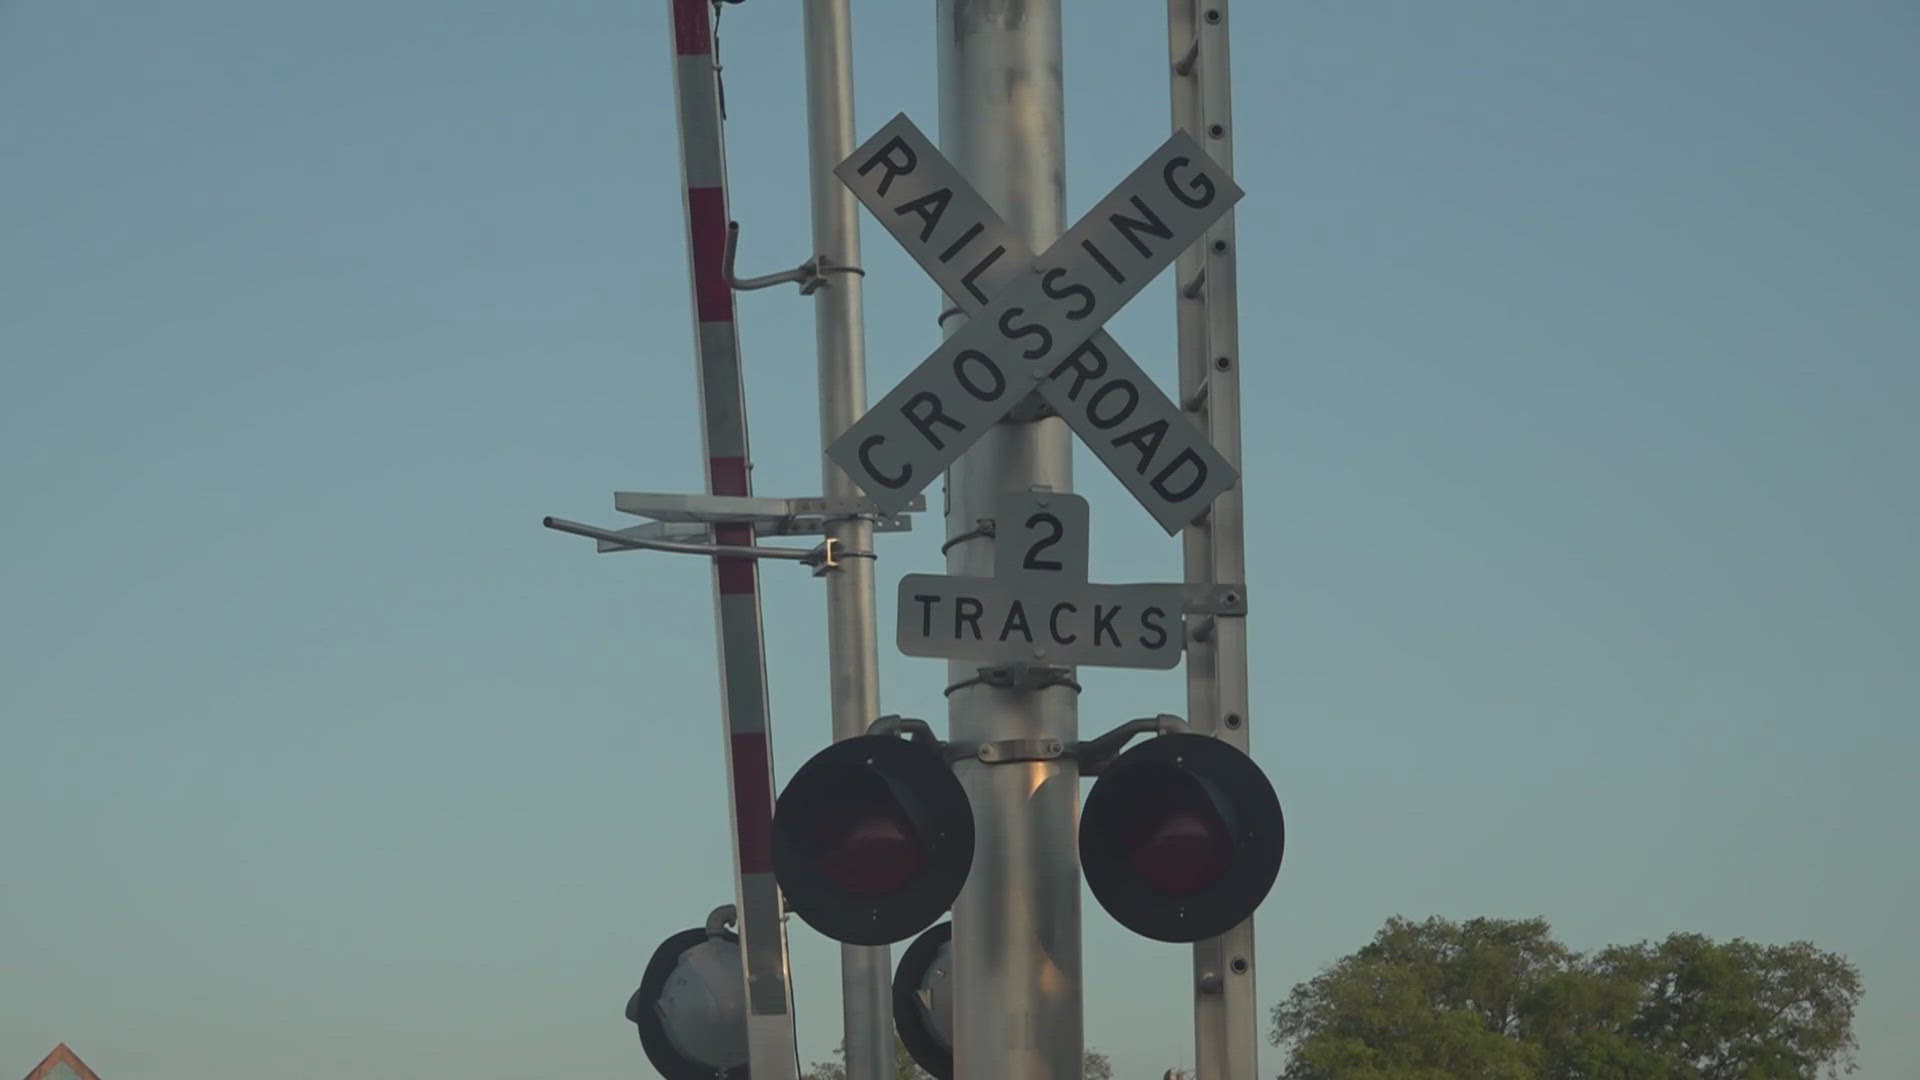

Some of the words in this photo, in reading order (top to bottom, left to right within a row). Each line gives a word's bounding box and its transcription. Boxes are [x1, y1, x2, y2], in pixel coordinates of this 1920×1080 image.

[857, 135, 1006, 306] RAIL
[1048, 338, 1208, 503] ROAD
[857, 156, 1216, 490] CROSSING
[914, 594, 1168, 650] TRACKS
[1022, 512, 1064, 571] 2
